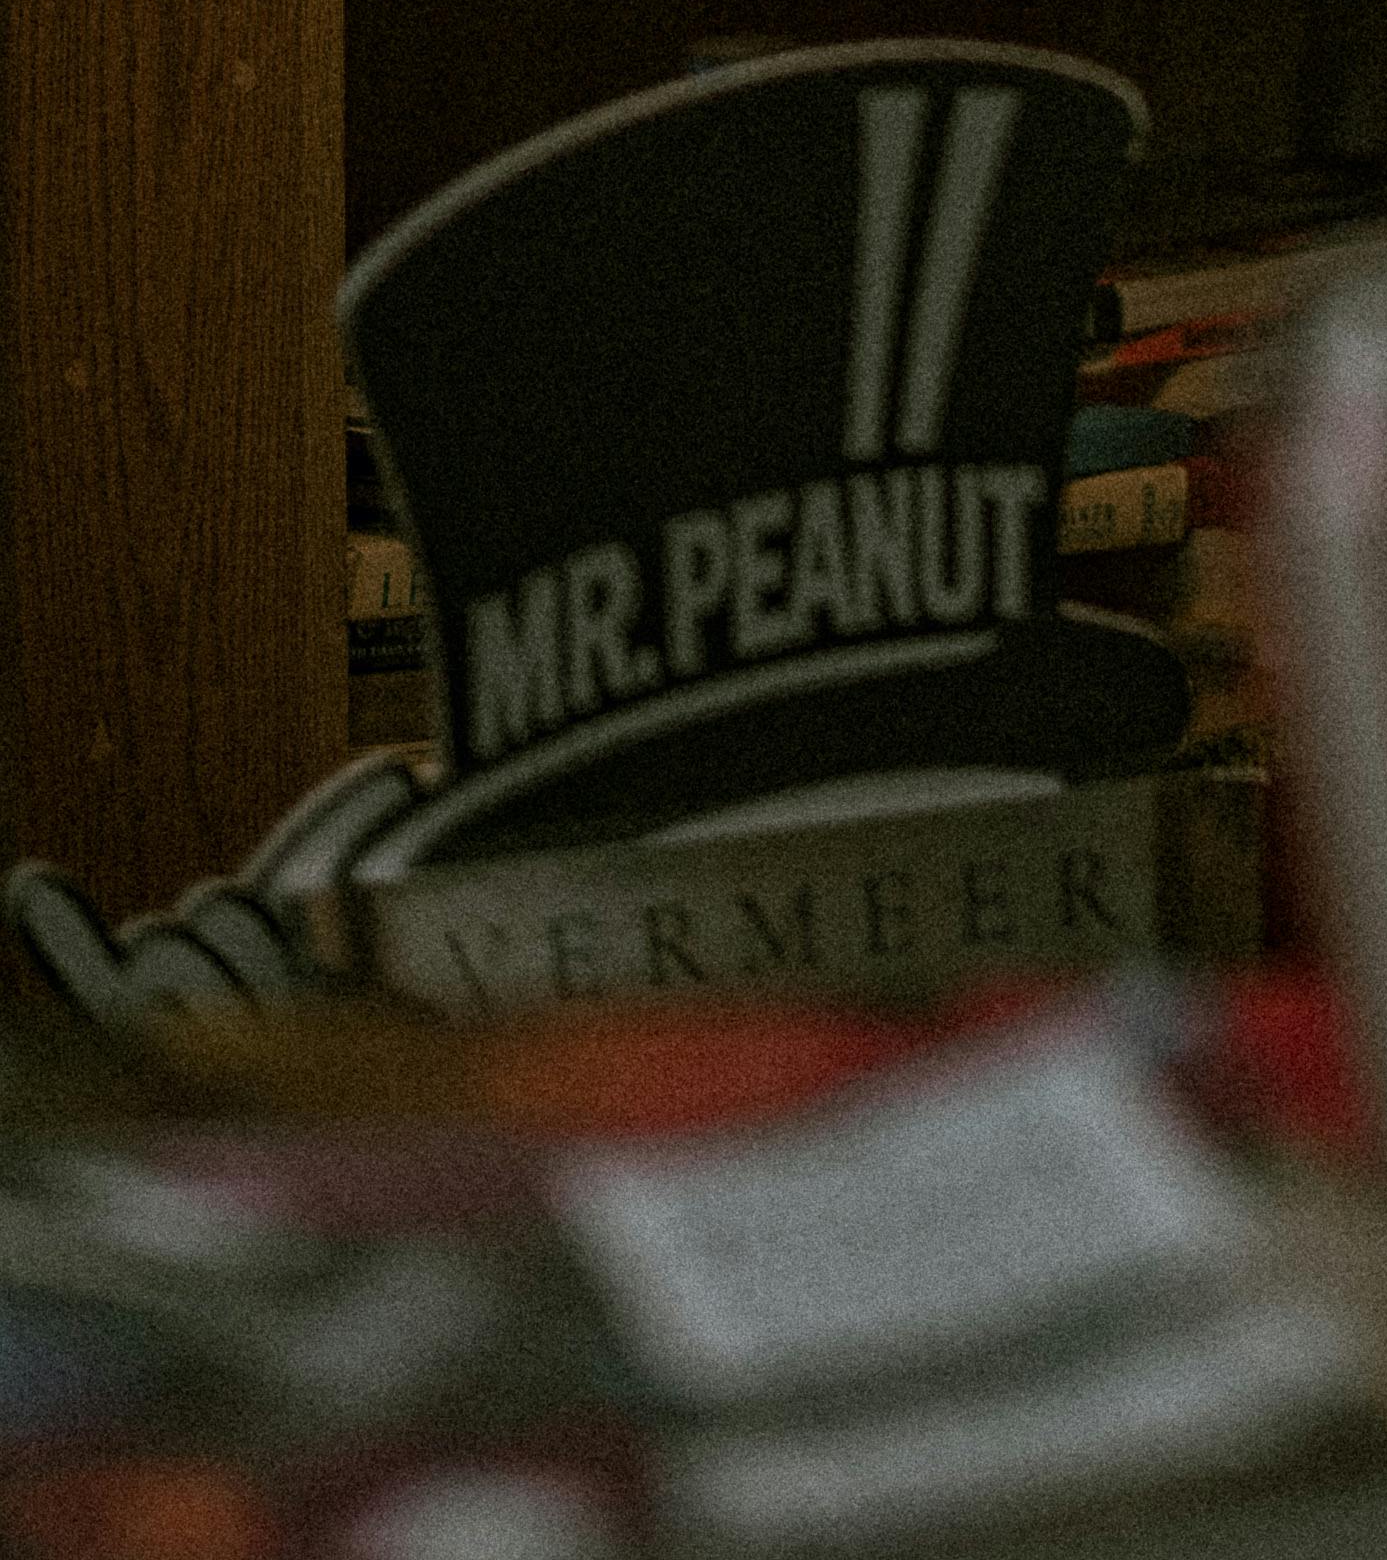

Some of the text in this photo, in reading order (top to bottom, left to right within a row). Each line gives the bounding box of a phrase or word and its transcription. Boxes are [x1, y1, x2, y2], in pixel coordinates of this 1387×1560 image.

[464, 463, 1048, 761] MR. PEANUT
[444, 844, 1124, 1028] VERMEER
